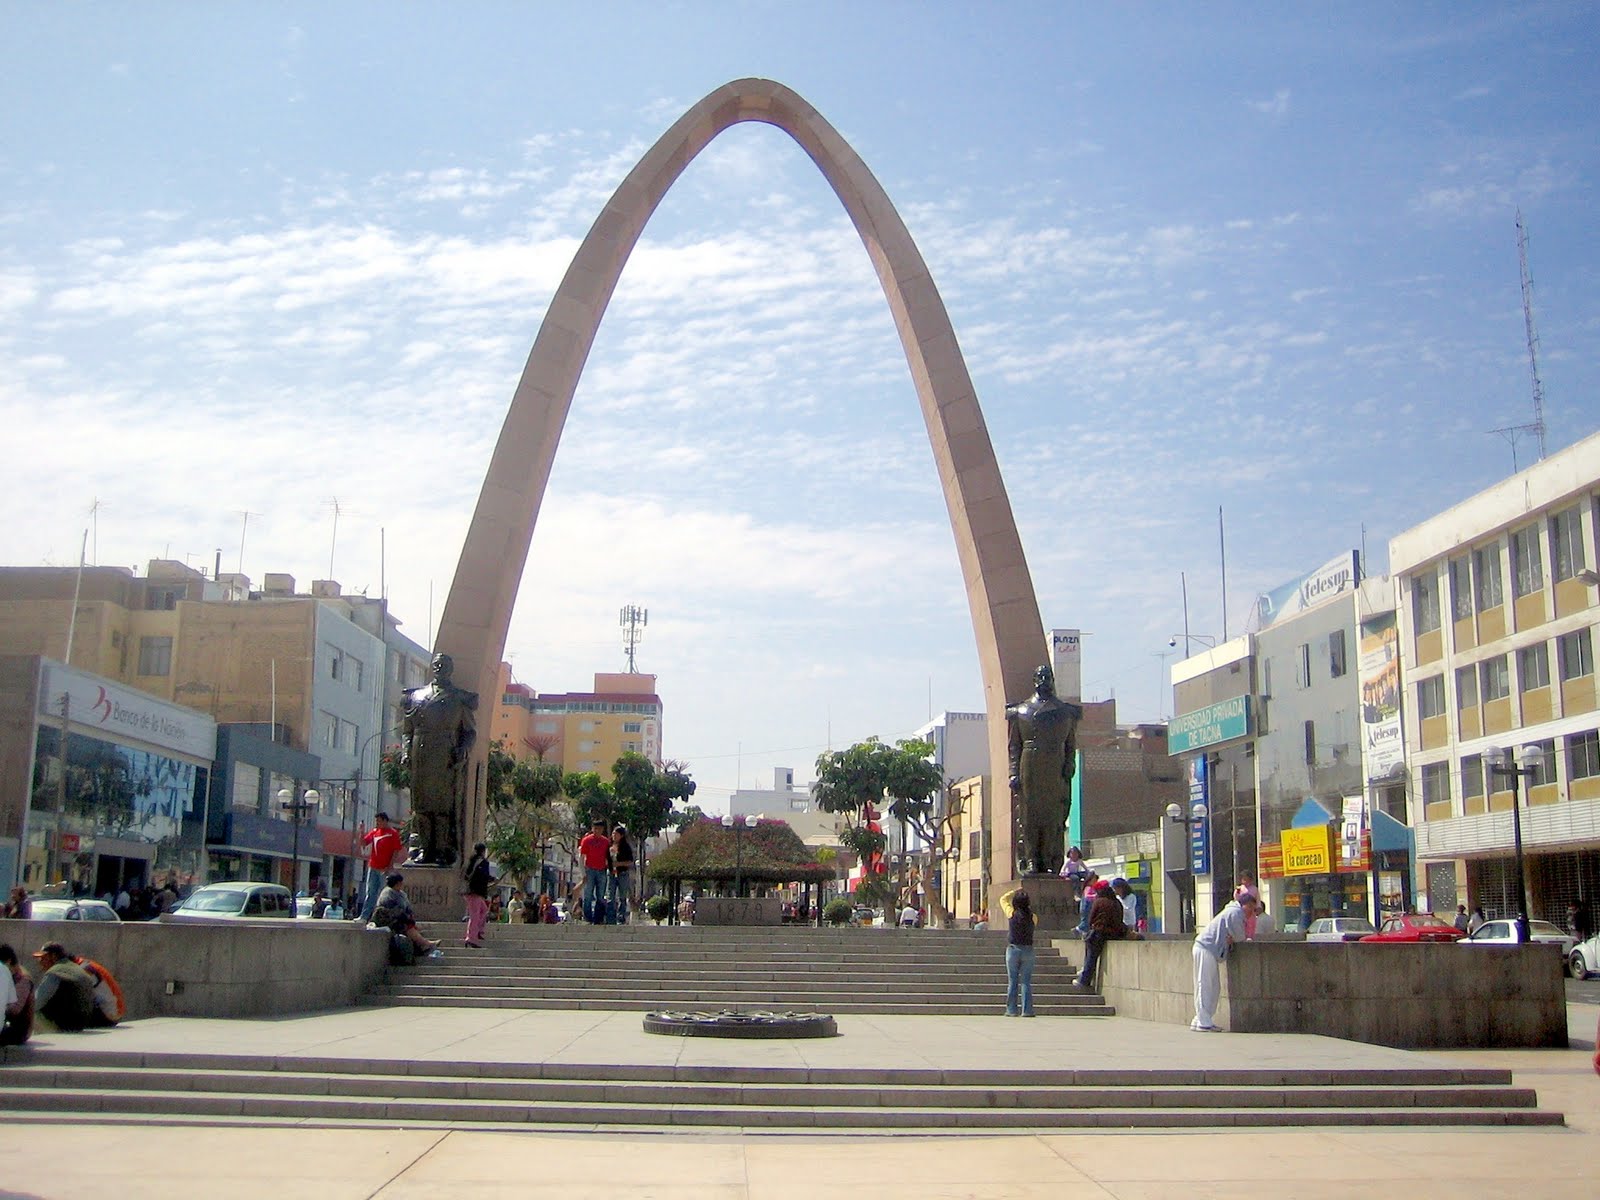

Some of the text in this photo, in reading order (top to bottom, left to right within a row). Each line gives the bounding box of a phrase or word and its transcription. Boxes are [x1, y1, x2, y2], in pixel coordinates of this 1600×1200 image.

[1304, 568, 1349, 600] telesup
[113, 701, 139, 727] Banco
[140, 711, 150, 730] de
[151, 713, 159, 732] la
[1169, 699, 1244, 737] UNIVERSIDAD PRIVADA
[1188, 724, 1223, 747] DE TACNA
[1288, 853, 1322, 867] la curacao
[403, 885, 449, 905] OGNESI
[716, 902, 763, 921] 1879
